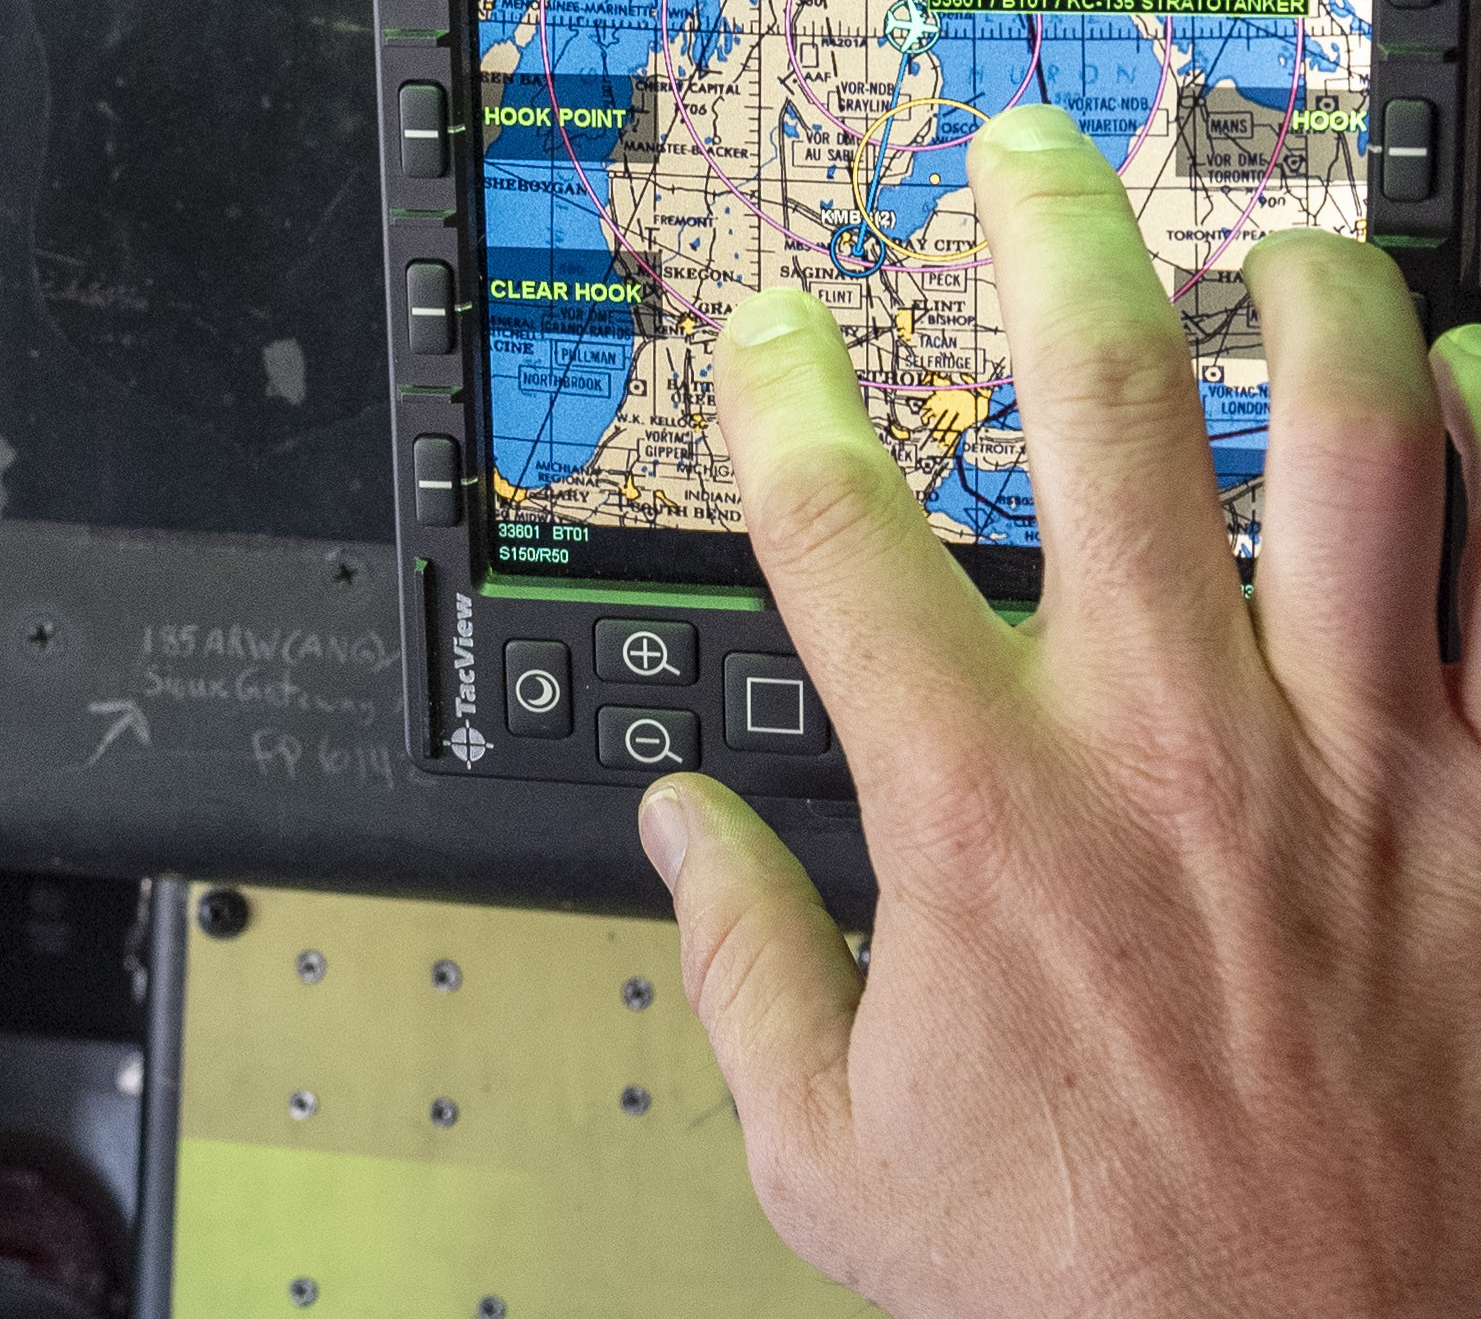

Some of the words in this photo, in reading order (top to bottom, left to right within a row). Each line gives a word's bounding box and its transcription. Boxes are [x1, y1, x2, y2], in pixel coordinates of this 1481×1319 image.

[690, 82, 741, 96] CAPITAL
[484, 107, 552, 127] HOOK
[559, 108, 627, 129] POINT
[1292, 110, 1368, 132] HOOK
[653, 214, 714, 228] FREMONT
[934, 239, 977, 252] CITY
[928, 272, 961, 287] PECK
[490, 280, 568, 300] CLEAR
[575, 282, 642, 303] HOOK
[818, 289, 853, 304] FLINT
[927, 315, 976, 326] BISHOP
[919, 336, 958, 349] TACAN
[645, 430, 690, 445] VORTAC
[693, 508, 742, 523] BEND
[498, 523, 540, 540] 33601
[552, 525, 589, 542] BT01
[499, 547, 569, 564] S150/R50
[453, 592, 478, 719] TacView
